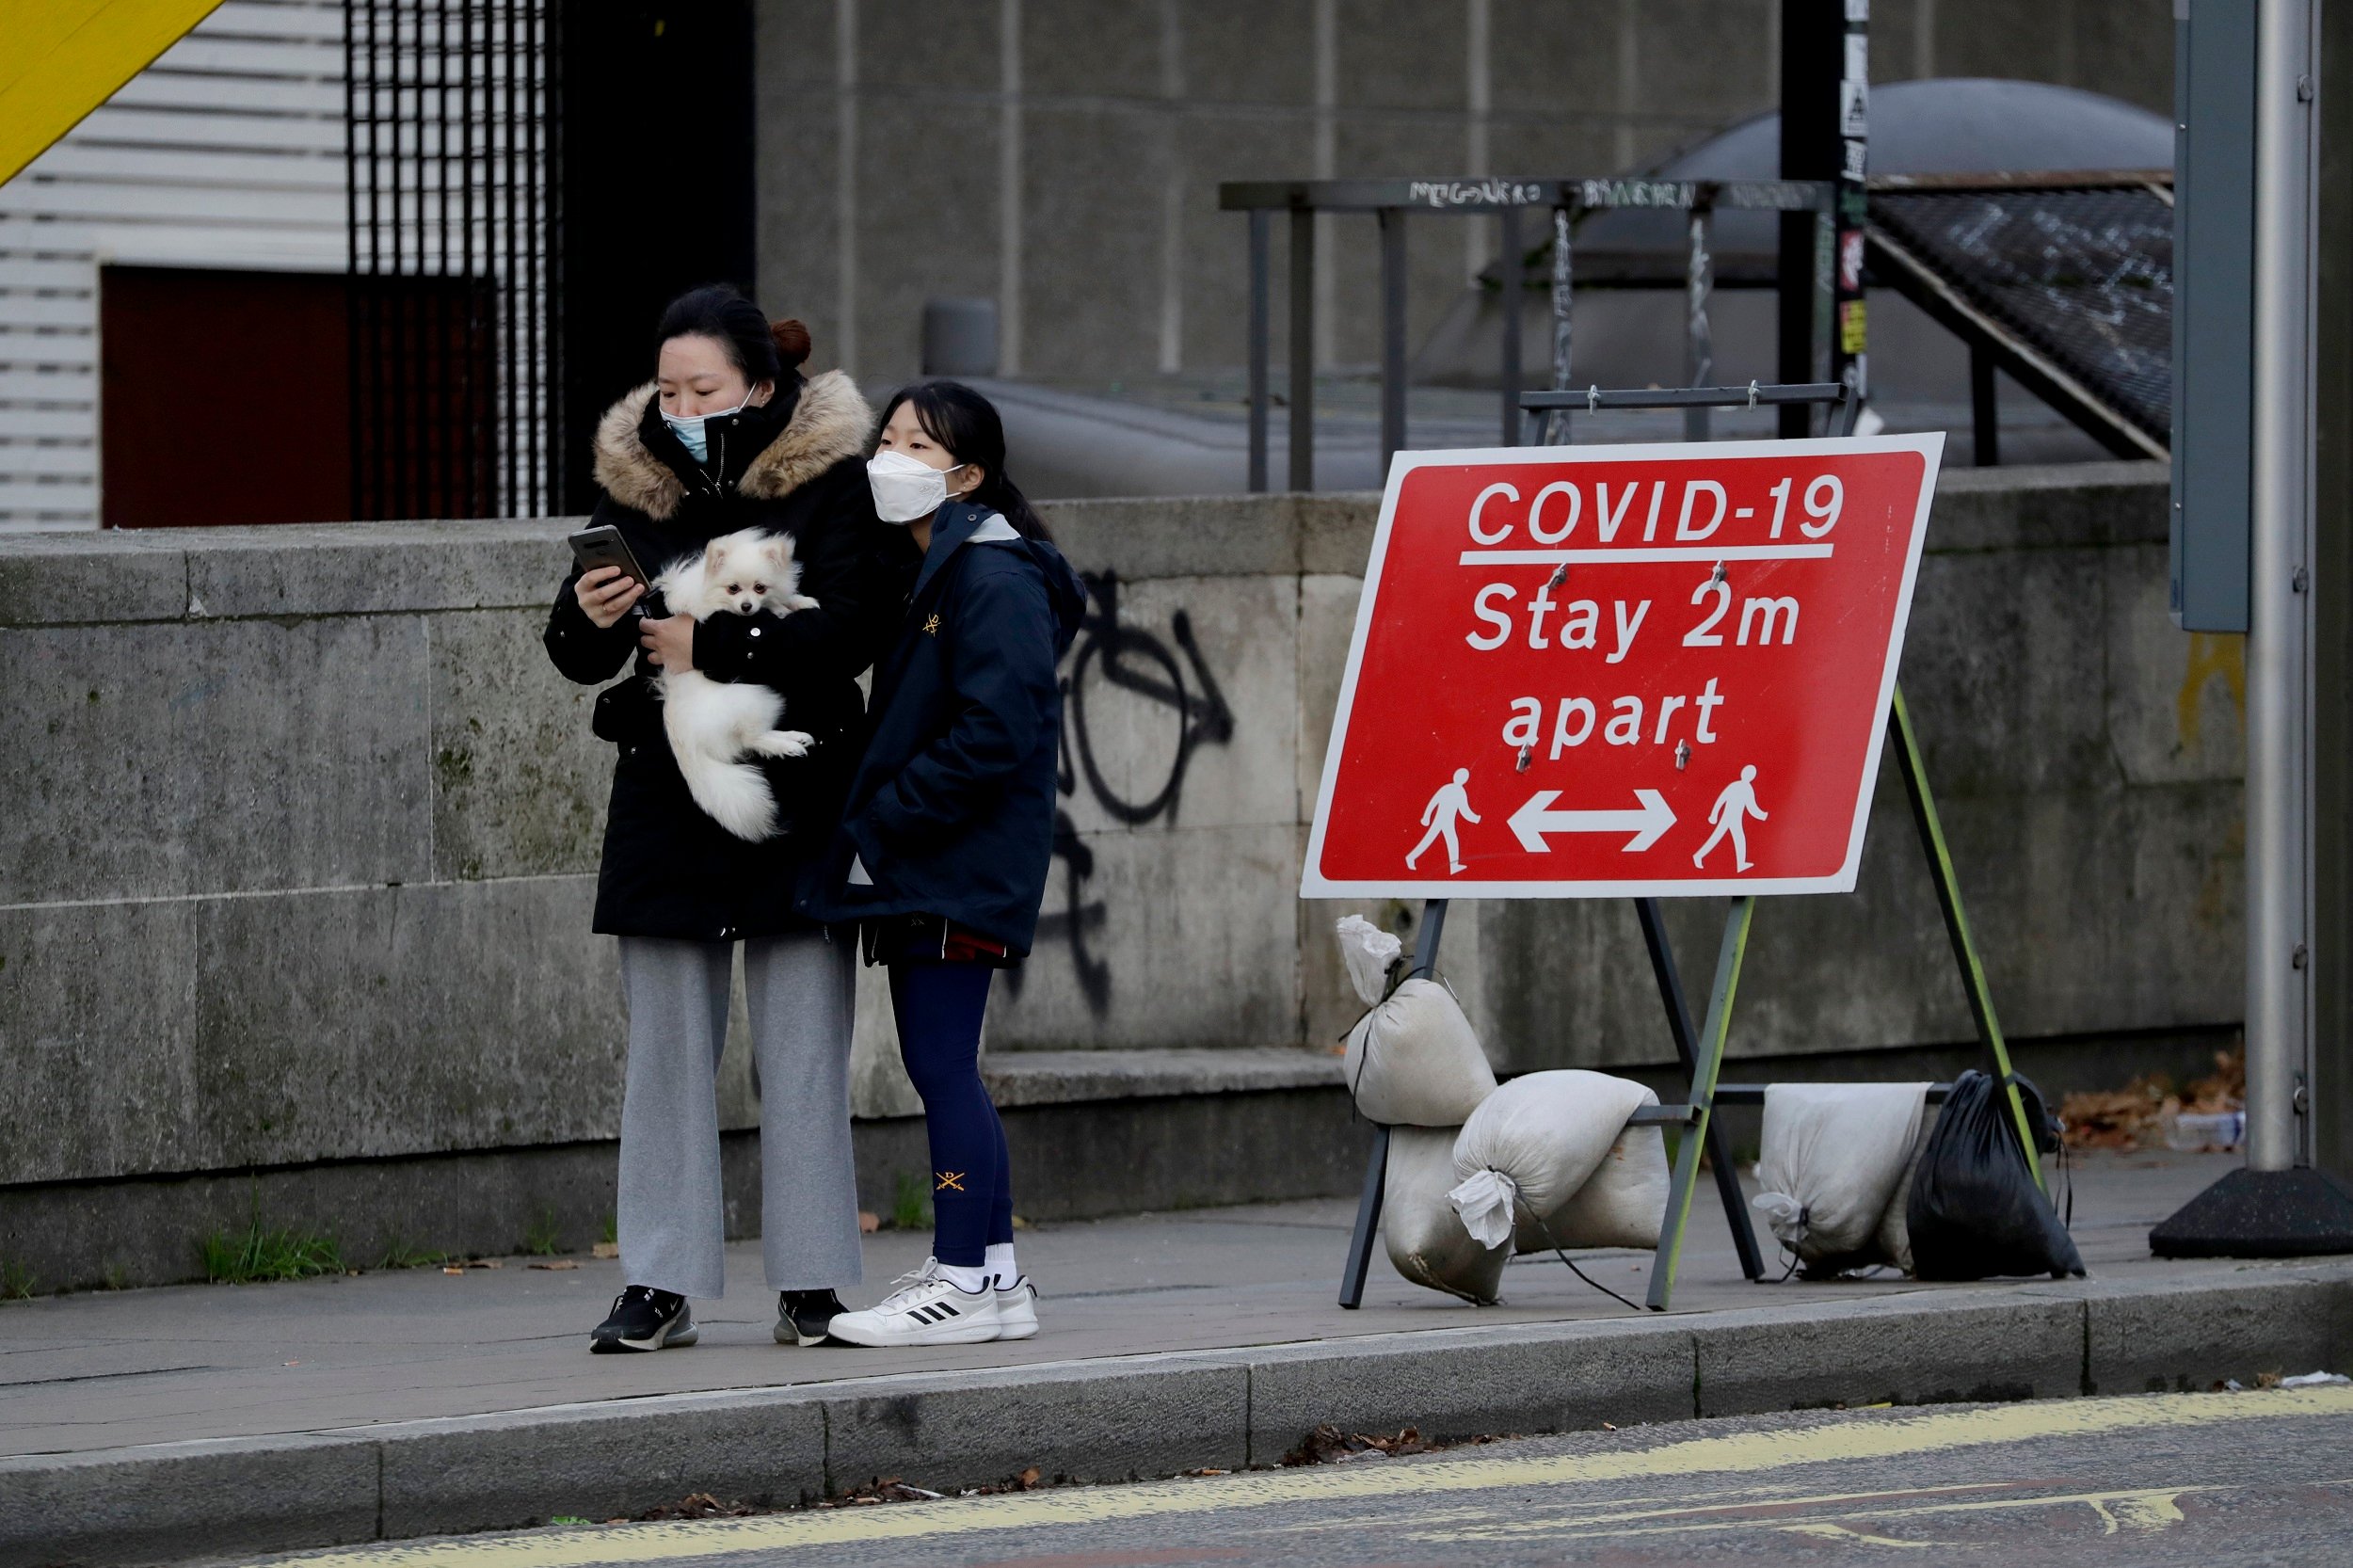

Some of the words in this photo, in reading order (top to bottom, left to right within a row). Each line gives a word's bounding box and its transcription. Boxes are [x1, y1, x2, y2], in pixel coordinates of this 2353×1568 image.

[1468, 474, 1844, 546] COVID-19
[1465, 582, 1652, 664] Stay
[1683, 581, 1800, 648] 2m
[1502, 678, 1725, 760] apart
